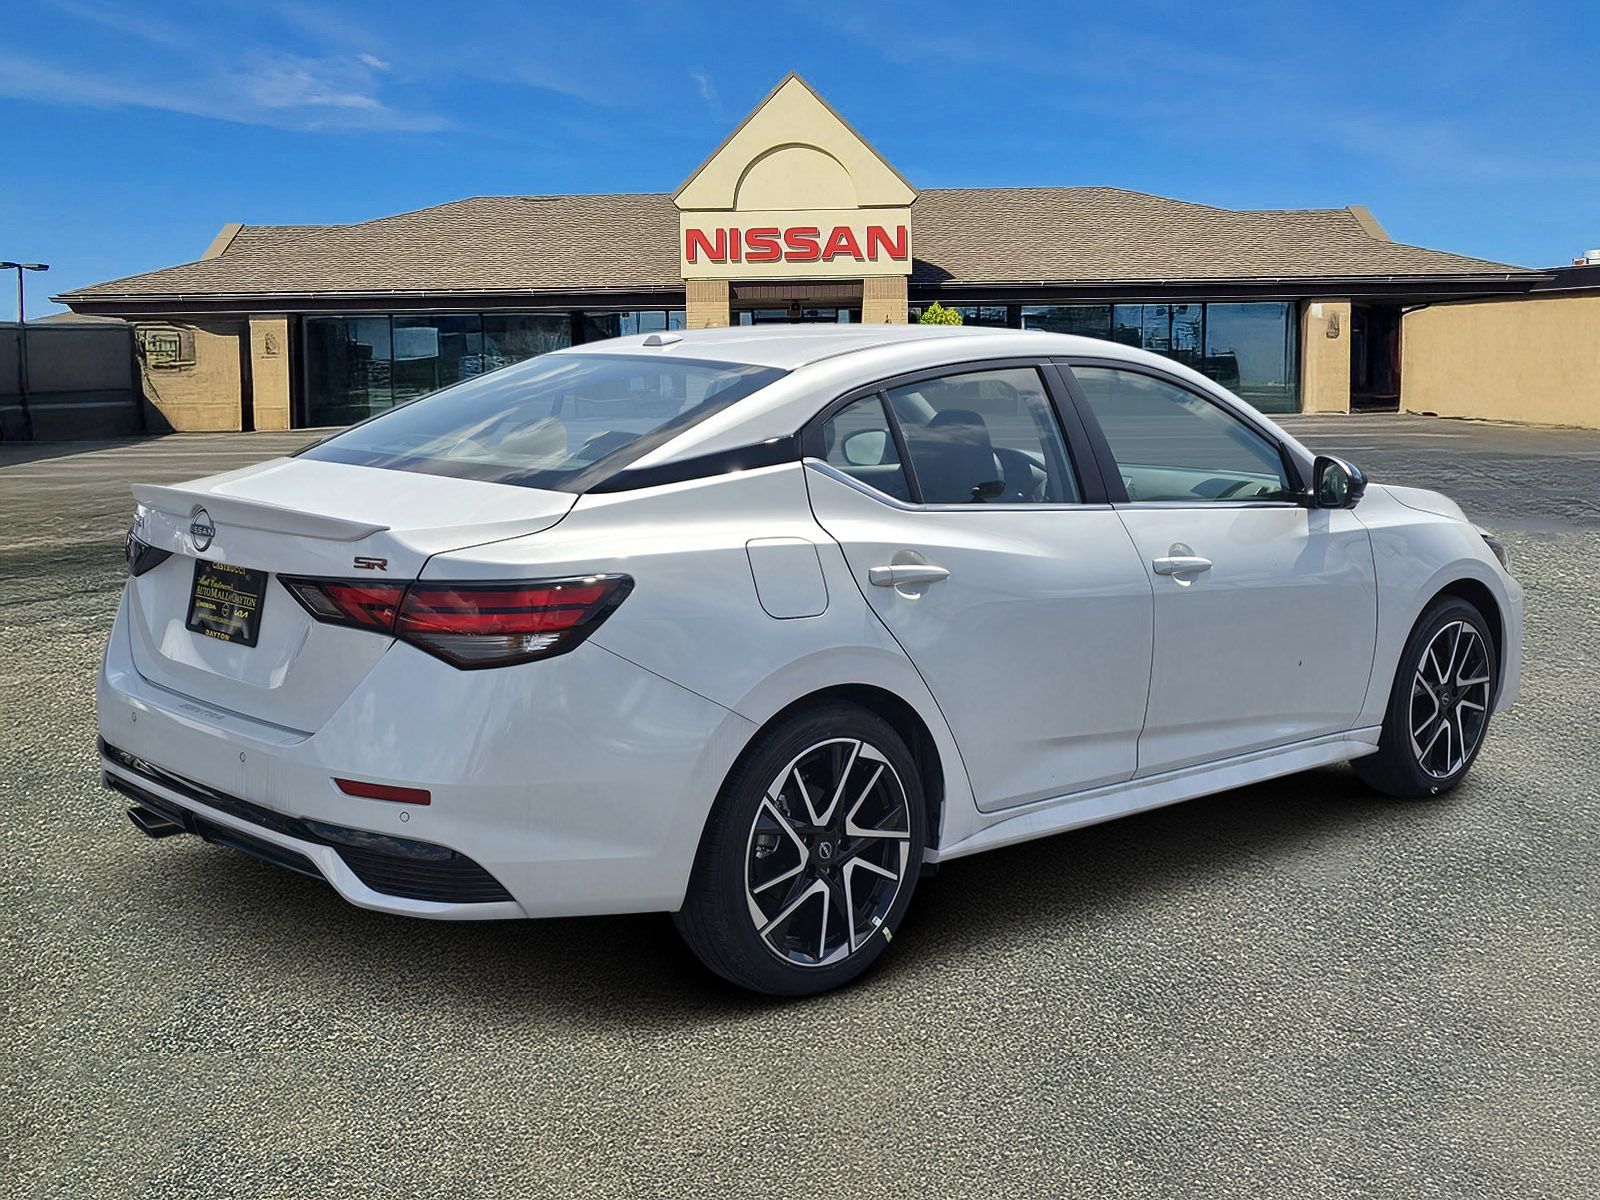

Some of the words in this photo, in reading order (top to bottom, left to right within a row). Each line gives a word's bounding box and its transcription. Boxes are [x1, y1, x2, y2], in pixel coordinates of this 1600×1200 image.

[686, 225, 908, 264] NISSAN
[353, 556, 388, 571] SR
[205, 629, 230, 640] DAYTON
